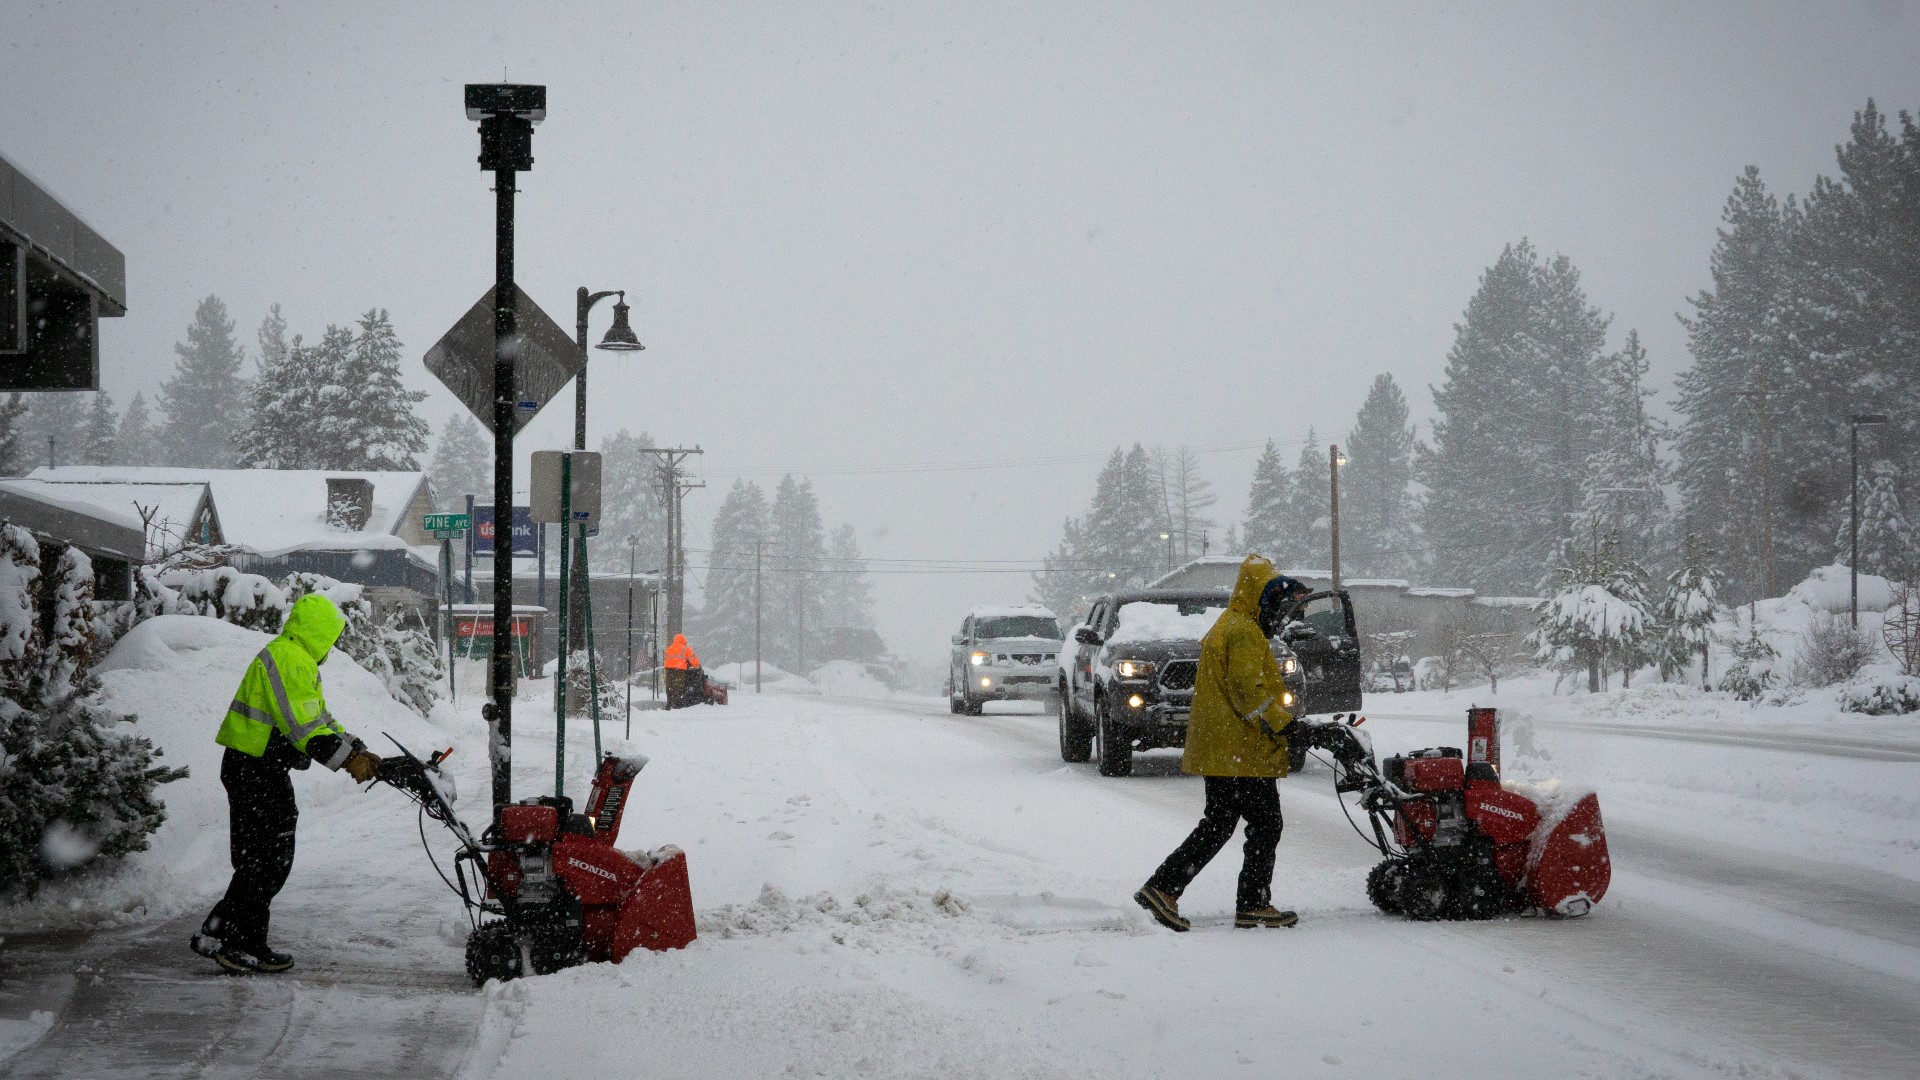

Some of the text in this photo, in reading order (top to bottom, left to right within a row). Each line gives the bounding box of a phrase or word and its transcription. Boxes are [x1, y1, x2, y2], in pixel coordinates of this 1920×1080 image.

[425, 516, 468, 528] PINE AVE
[480, 524, 531, 536] usnk
[1480, 802, 1524, 821] HONDA
[568, 857, 617, 882] HONDA
